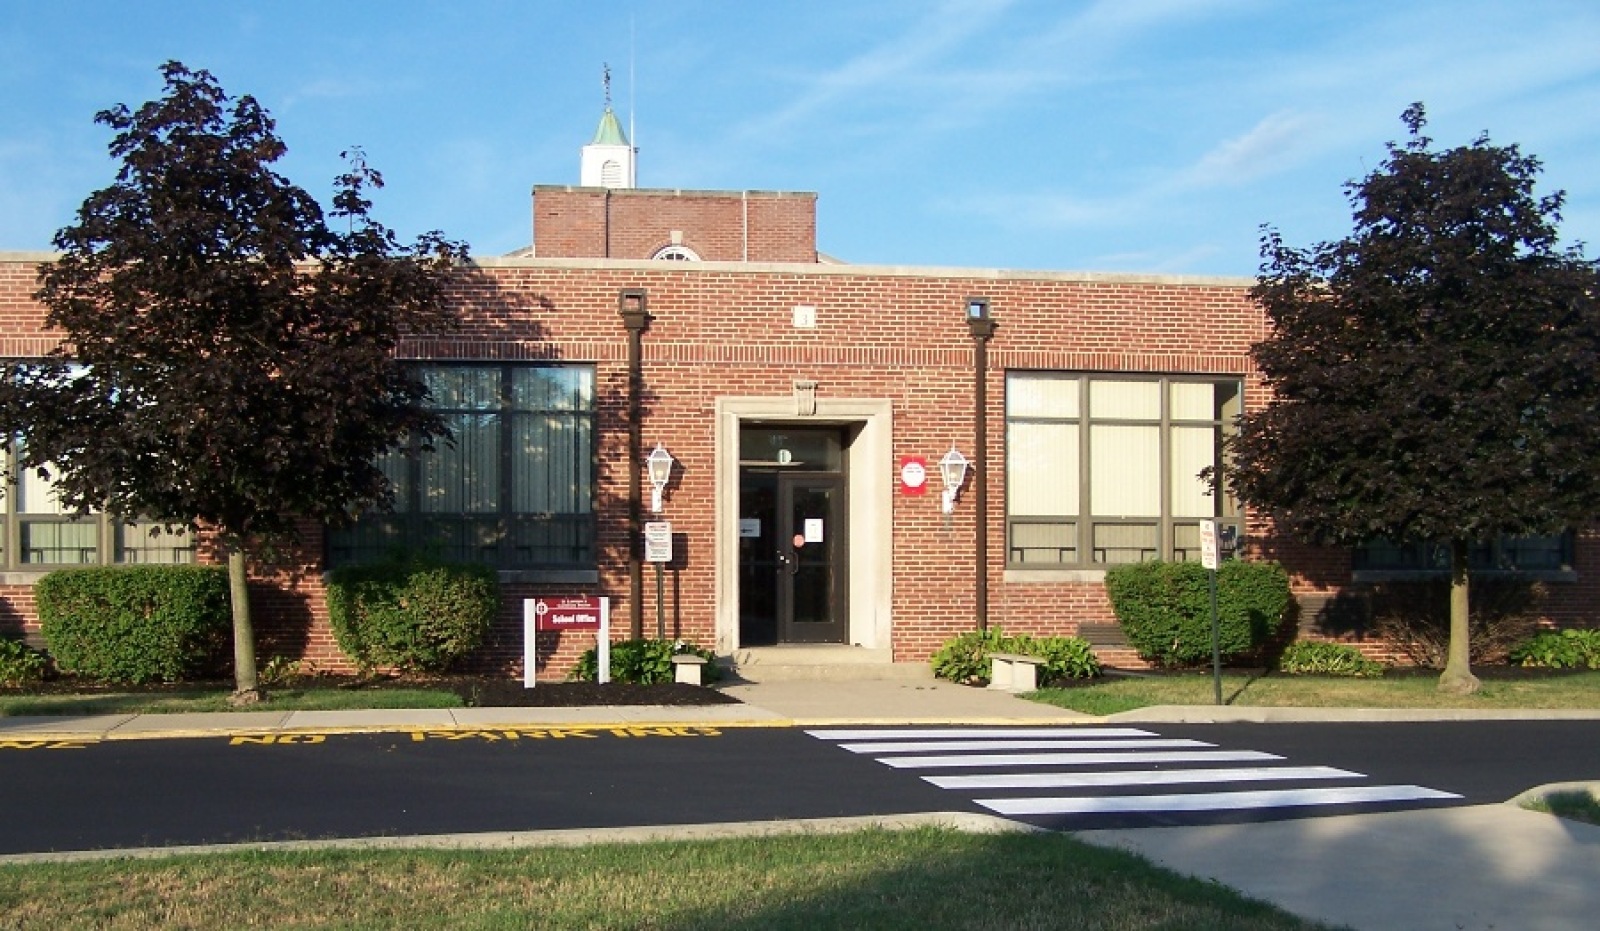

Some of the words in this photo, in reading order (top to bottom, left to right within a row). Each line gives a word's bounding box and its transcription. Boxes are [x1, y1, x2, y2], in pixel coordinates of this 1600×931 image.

[552, 614, 575, 624] School
[576, 614, 597, 623] Office
[228, 733, 326, 746] NO
[410, 726, 723, 742] PARKING
